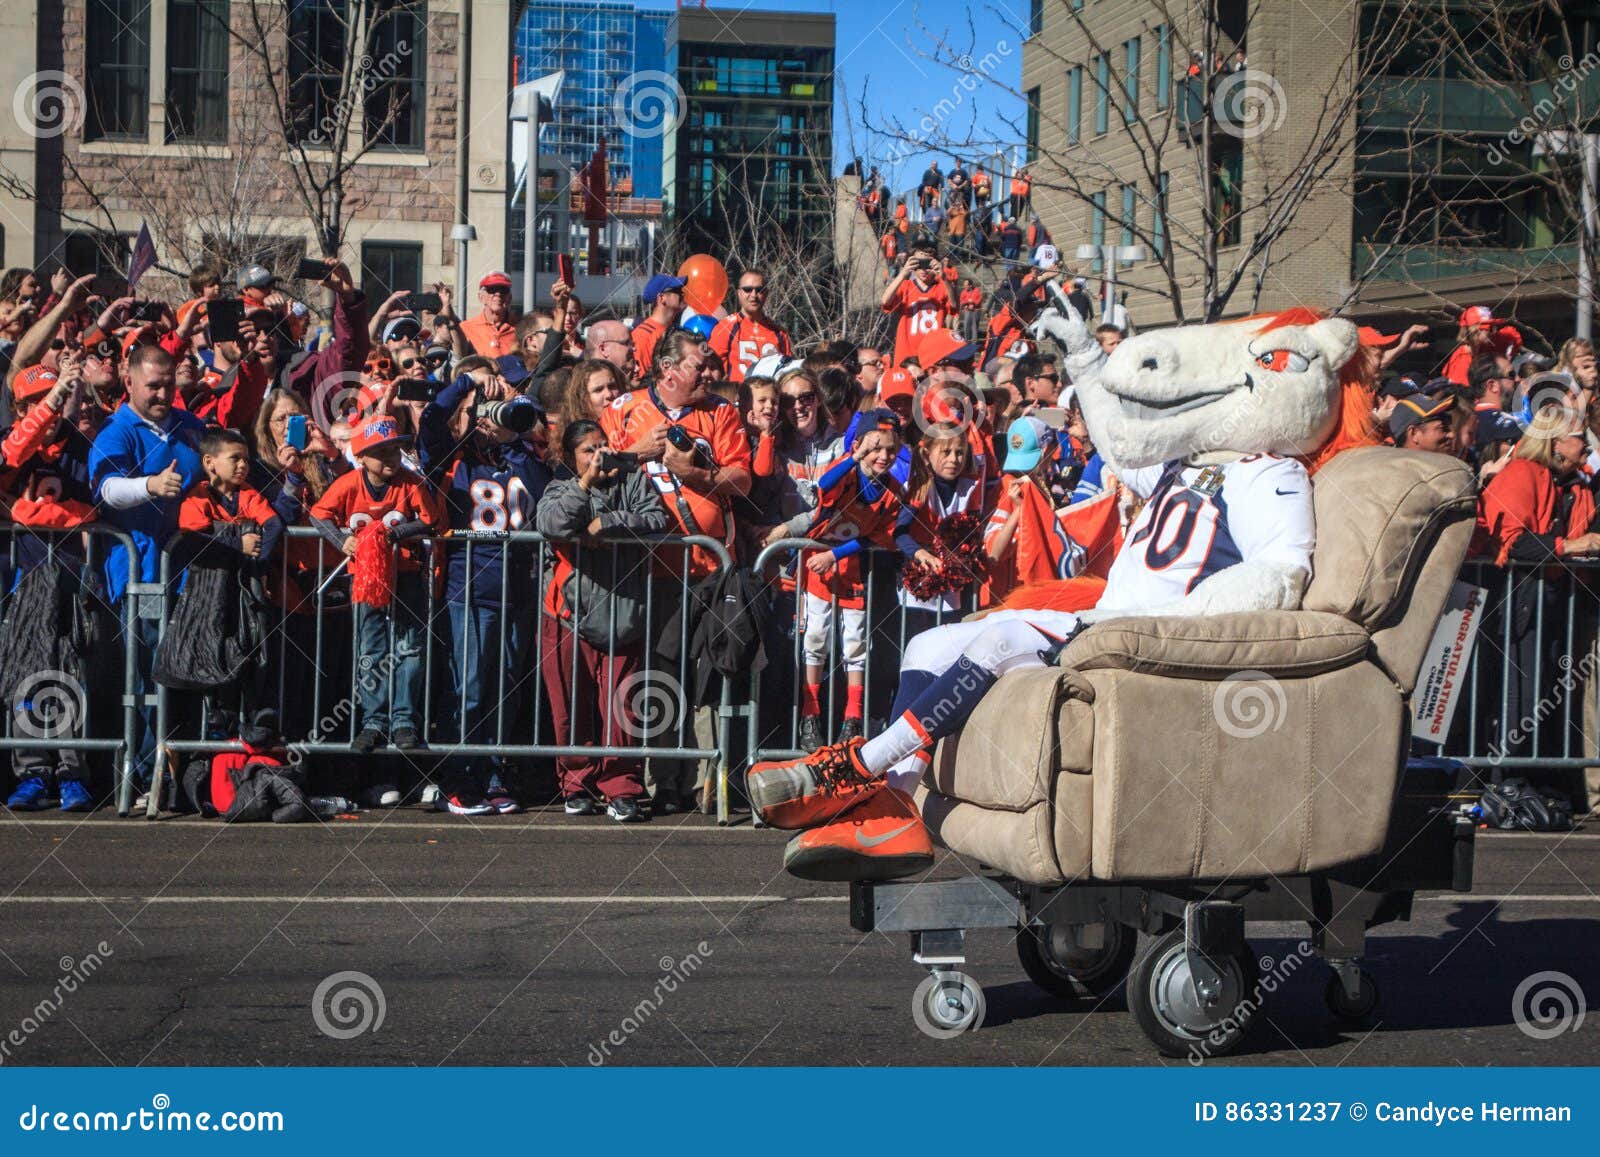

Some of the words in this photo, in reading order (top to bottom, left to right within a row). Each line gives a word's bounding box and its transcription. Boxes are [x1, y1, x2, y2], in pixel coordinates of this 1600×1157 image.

[911, 302, 938, 335] 18
[470, 476, 535, 532] 80
[1436, 646, 1451, 684] SUPER
[1416, 665, 1437, 721] CHAMPIONS
[1424, 684, 1441, 720] BOWL
